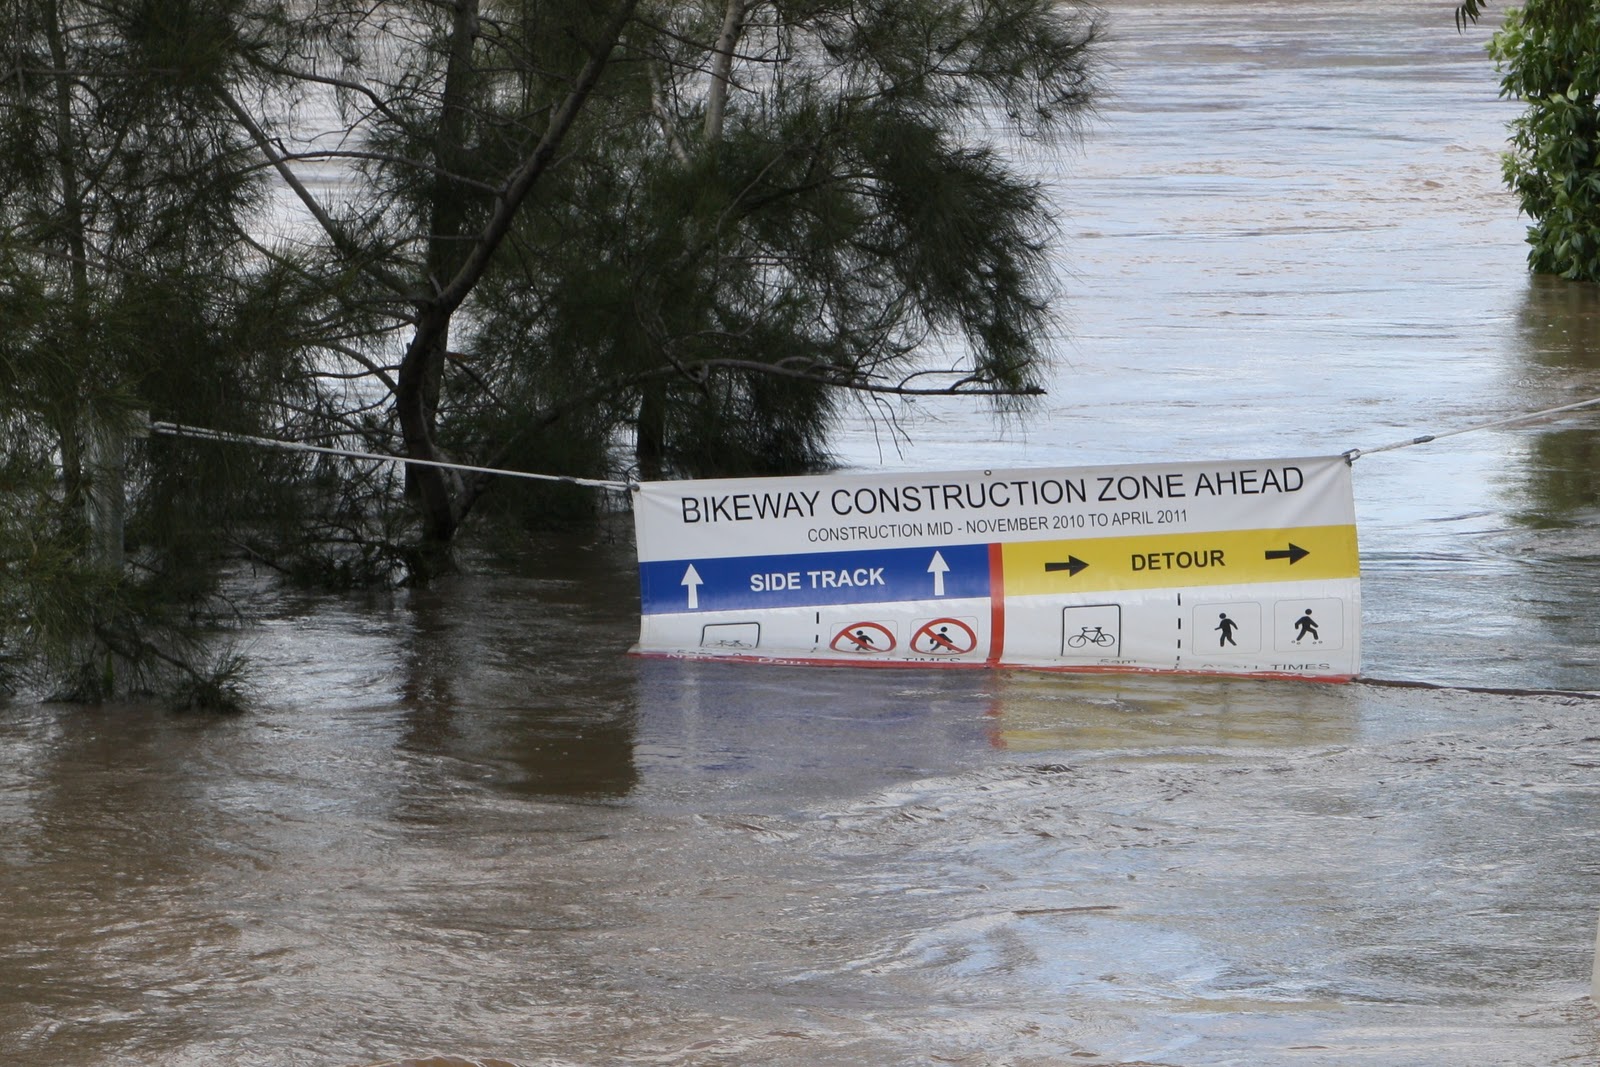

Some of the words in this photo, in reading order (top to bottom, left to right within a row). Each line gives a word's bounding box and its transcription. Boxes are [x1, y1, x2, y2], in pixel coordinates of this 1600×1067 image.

[682, 490, 820, 523] BIKEWAY
[831, 478, 1087, 516] CONSTRUCTION
[1097, 473, 1186, 502] ZONE
[1194, 466, 1304, 497] AHEAD
[808, 522, 923, 543] CONSTRUCTION
[927, 520, 953, 536] MID
[966, 515, 1048, 534] NOVEMBER
[1052, 513, 1085, 530] 2010
[1088, 512, 1109, 528] TO
[1112, 510, 1153, 527] APRIL
[1157, 509, 1188, 525] 2011
[1131, 549, 1226, 572] DETOUR
[750, 571, 801, 592] SIDE
[807, 567, 885, 589] TRACK
[1270, 663, 1330, 671] TIMES
